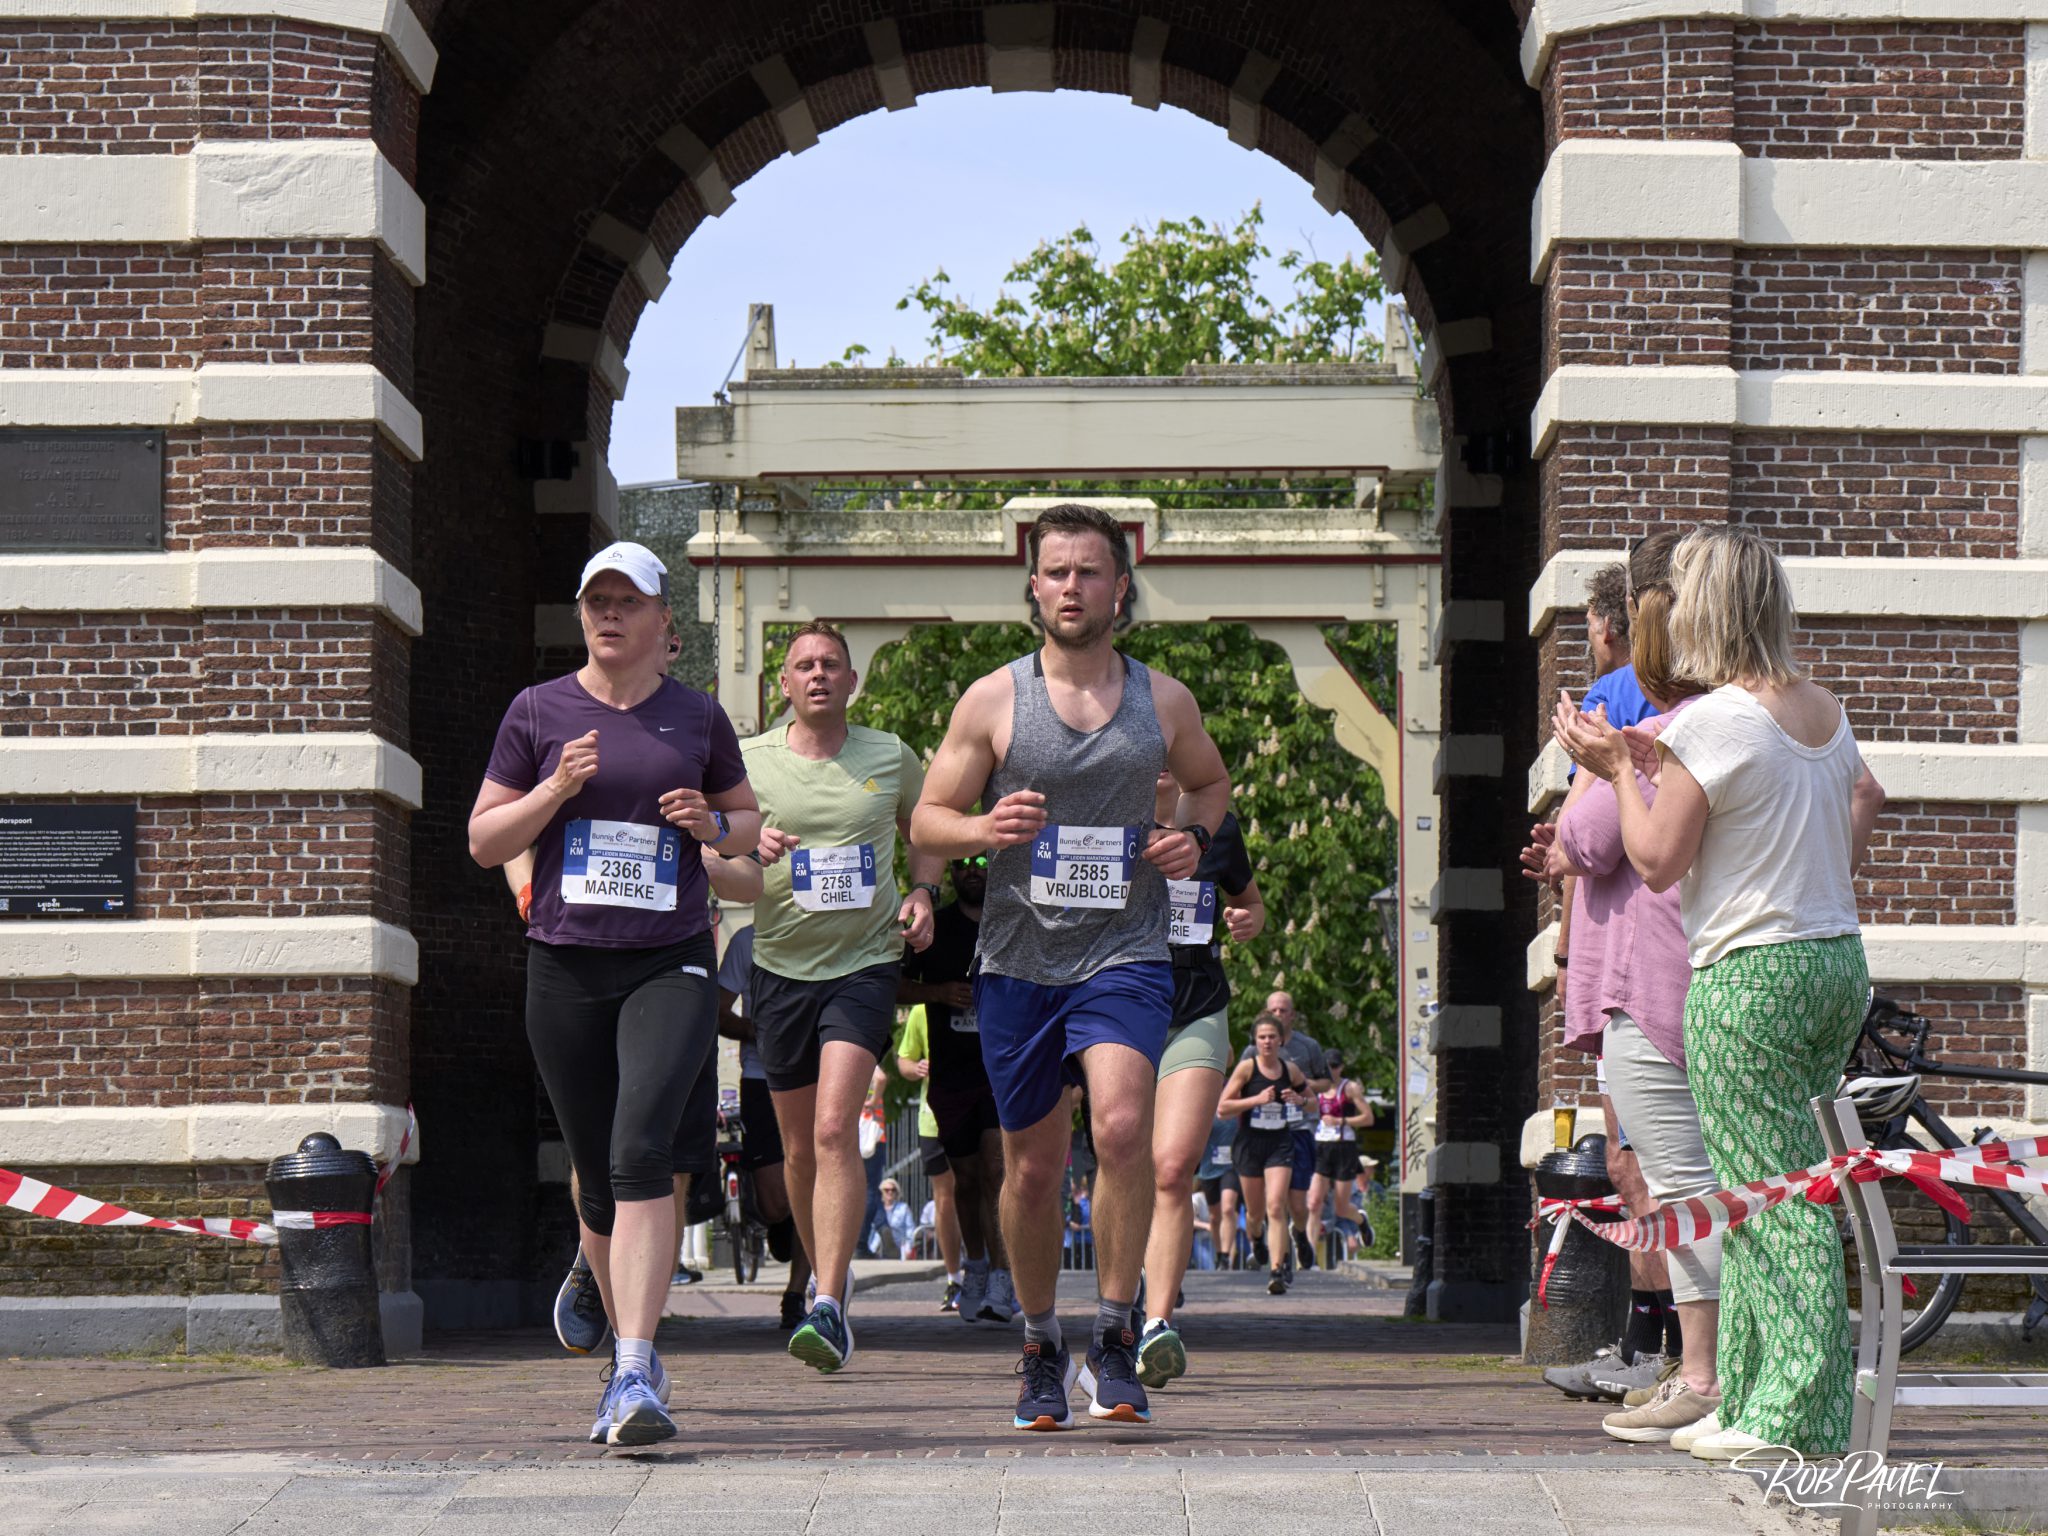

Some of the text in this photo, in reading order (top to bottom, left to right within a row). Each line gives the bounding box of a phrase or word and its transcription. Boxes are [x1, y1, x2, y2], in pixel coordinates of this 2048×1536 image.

[572, 838, 582, 846] 21
[629, 836, 656, 846] Partners
[1040, 842, 1049, 850] 21
[570, 847, 584, 856] KM
[662, 844, 673, 861] B
[1038, 850, 1051, 859] KM
[1128, 842, 1136, 859] C
[864, 856, 872, 869] D
[600, 860, 642, 880] 2366
[1069, 864, 1109, 881] 2585
[822, 875, 852, 890] 2758
[584, 880, 654, 900] MARIEKE
[1046, 882, 1128, 899] VRIJBLOED
[821, 890, 855, 904] CHIEL
[1202, 894, 1212, 906] C
[1170, 925, 1189, 937] RIE
